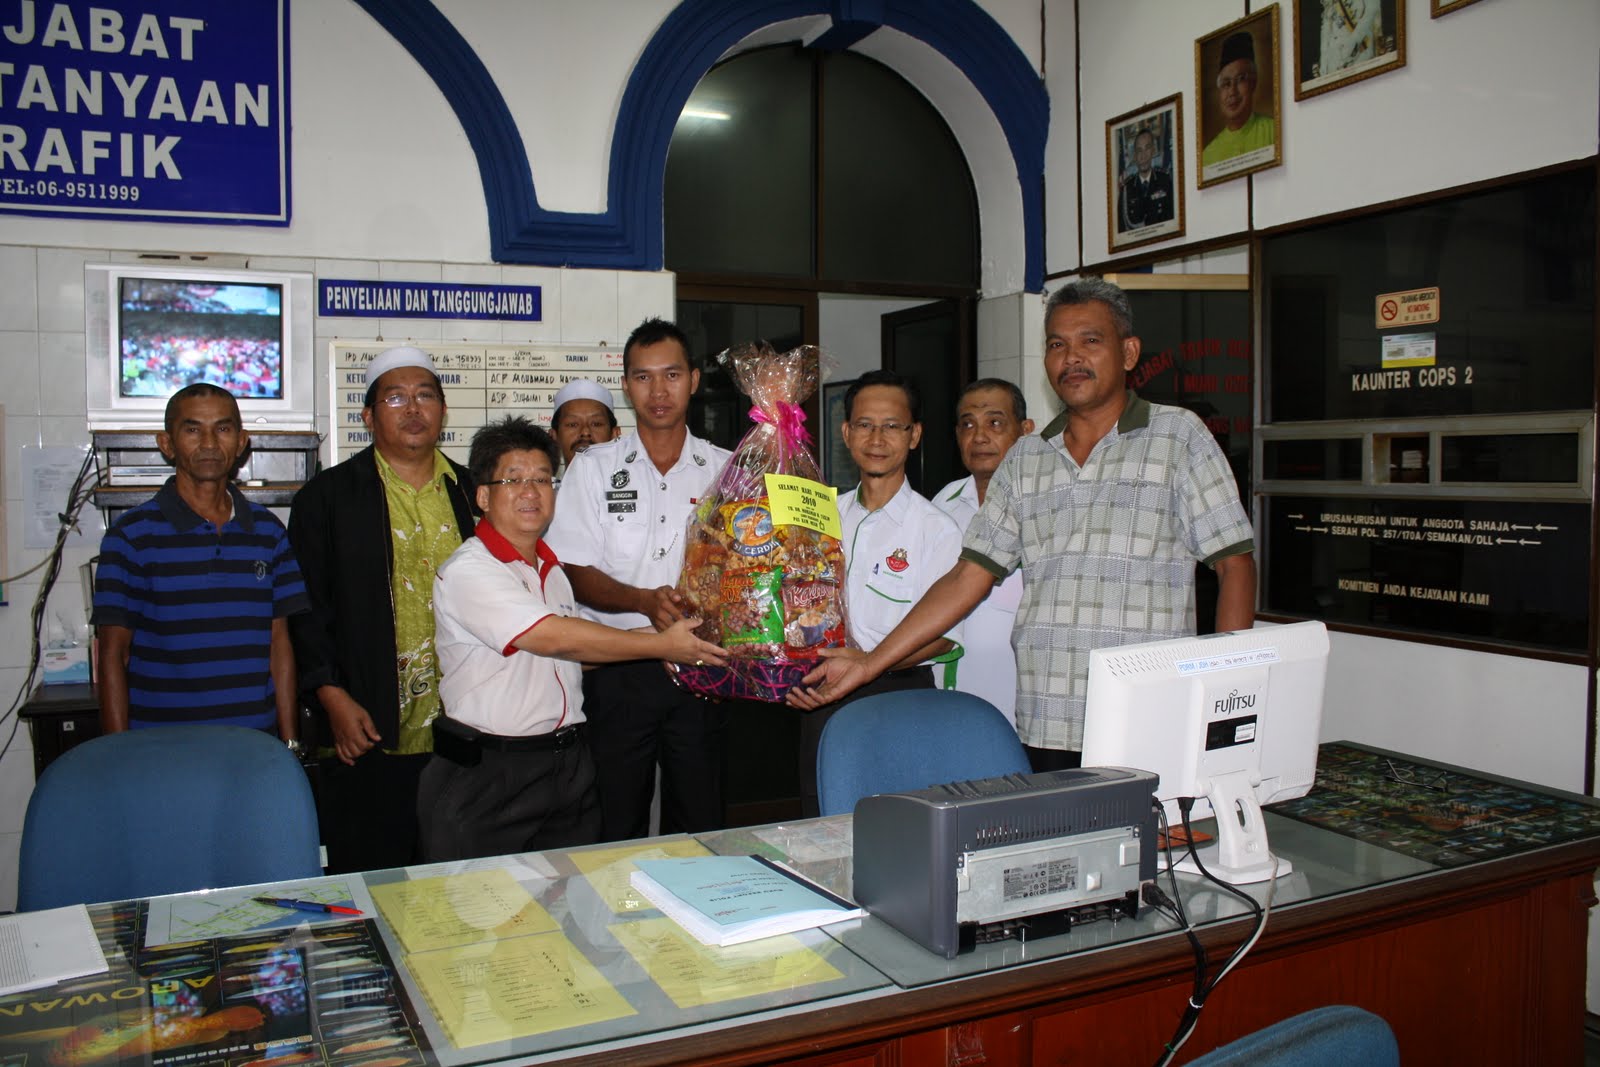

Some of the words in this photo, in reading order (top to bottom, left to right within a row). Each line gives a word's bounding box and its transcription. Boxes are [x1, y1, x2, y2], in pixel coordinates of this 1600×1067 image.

[326, 286, 400, 311] PENYELIAAN
[405, 289, 428, 312] DAN
[432, 290, 533, 315] TANGGUNGJAWAB
[346, 374, 366, 384] KETU
[1352, 370, 1411, 391] KAUNTER
[1418, 366, 1456, 387] COPS
[1464, 366, 1473, 385] 2
[346, 393, 366, 403] KETU
[347, 412, 362, 423] PEG
[801, 495, 817, 507] 2010
[1320, 513, 1387, 526] URUSAN-URUSAN
[1390, 516, 1418, 527] UNTUK
[1423, 518, 1465, 530] ANGGOTA
[1470, 520, 1510, 532] SAHAJA
[1331, 526, 1358, 536] SERAH
[1338, 579, 1380, 594] KOMITMEN
[1383, 583, 1407, 597] ANDA
[1410, 586, 1457, 602] KEJAYAAN
[1460, 591, 1490, 606] KAMI
[1214, 689, 1256, 715] FUJITSU
